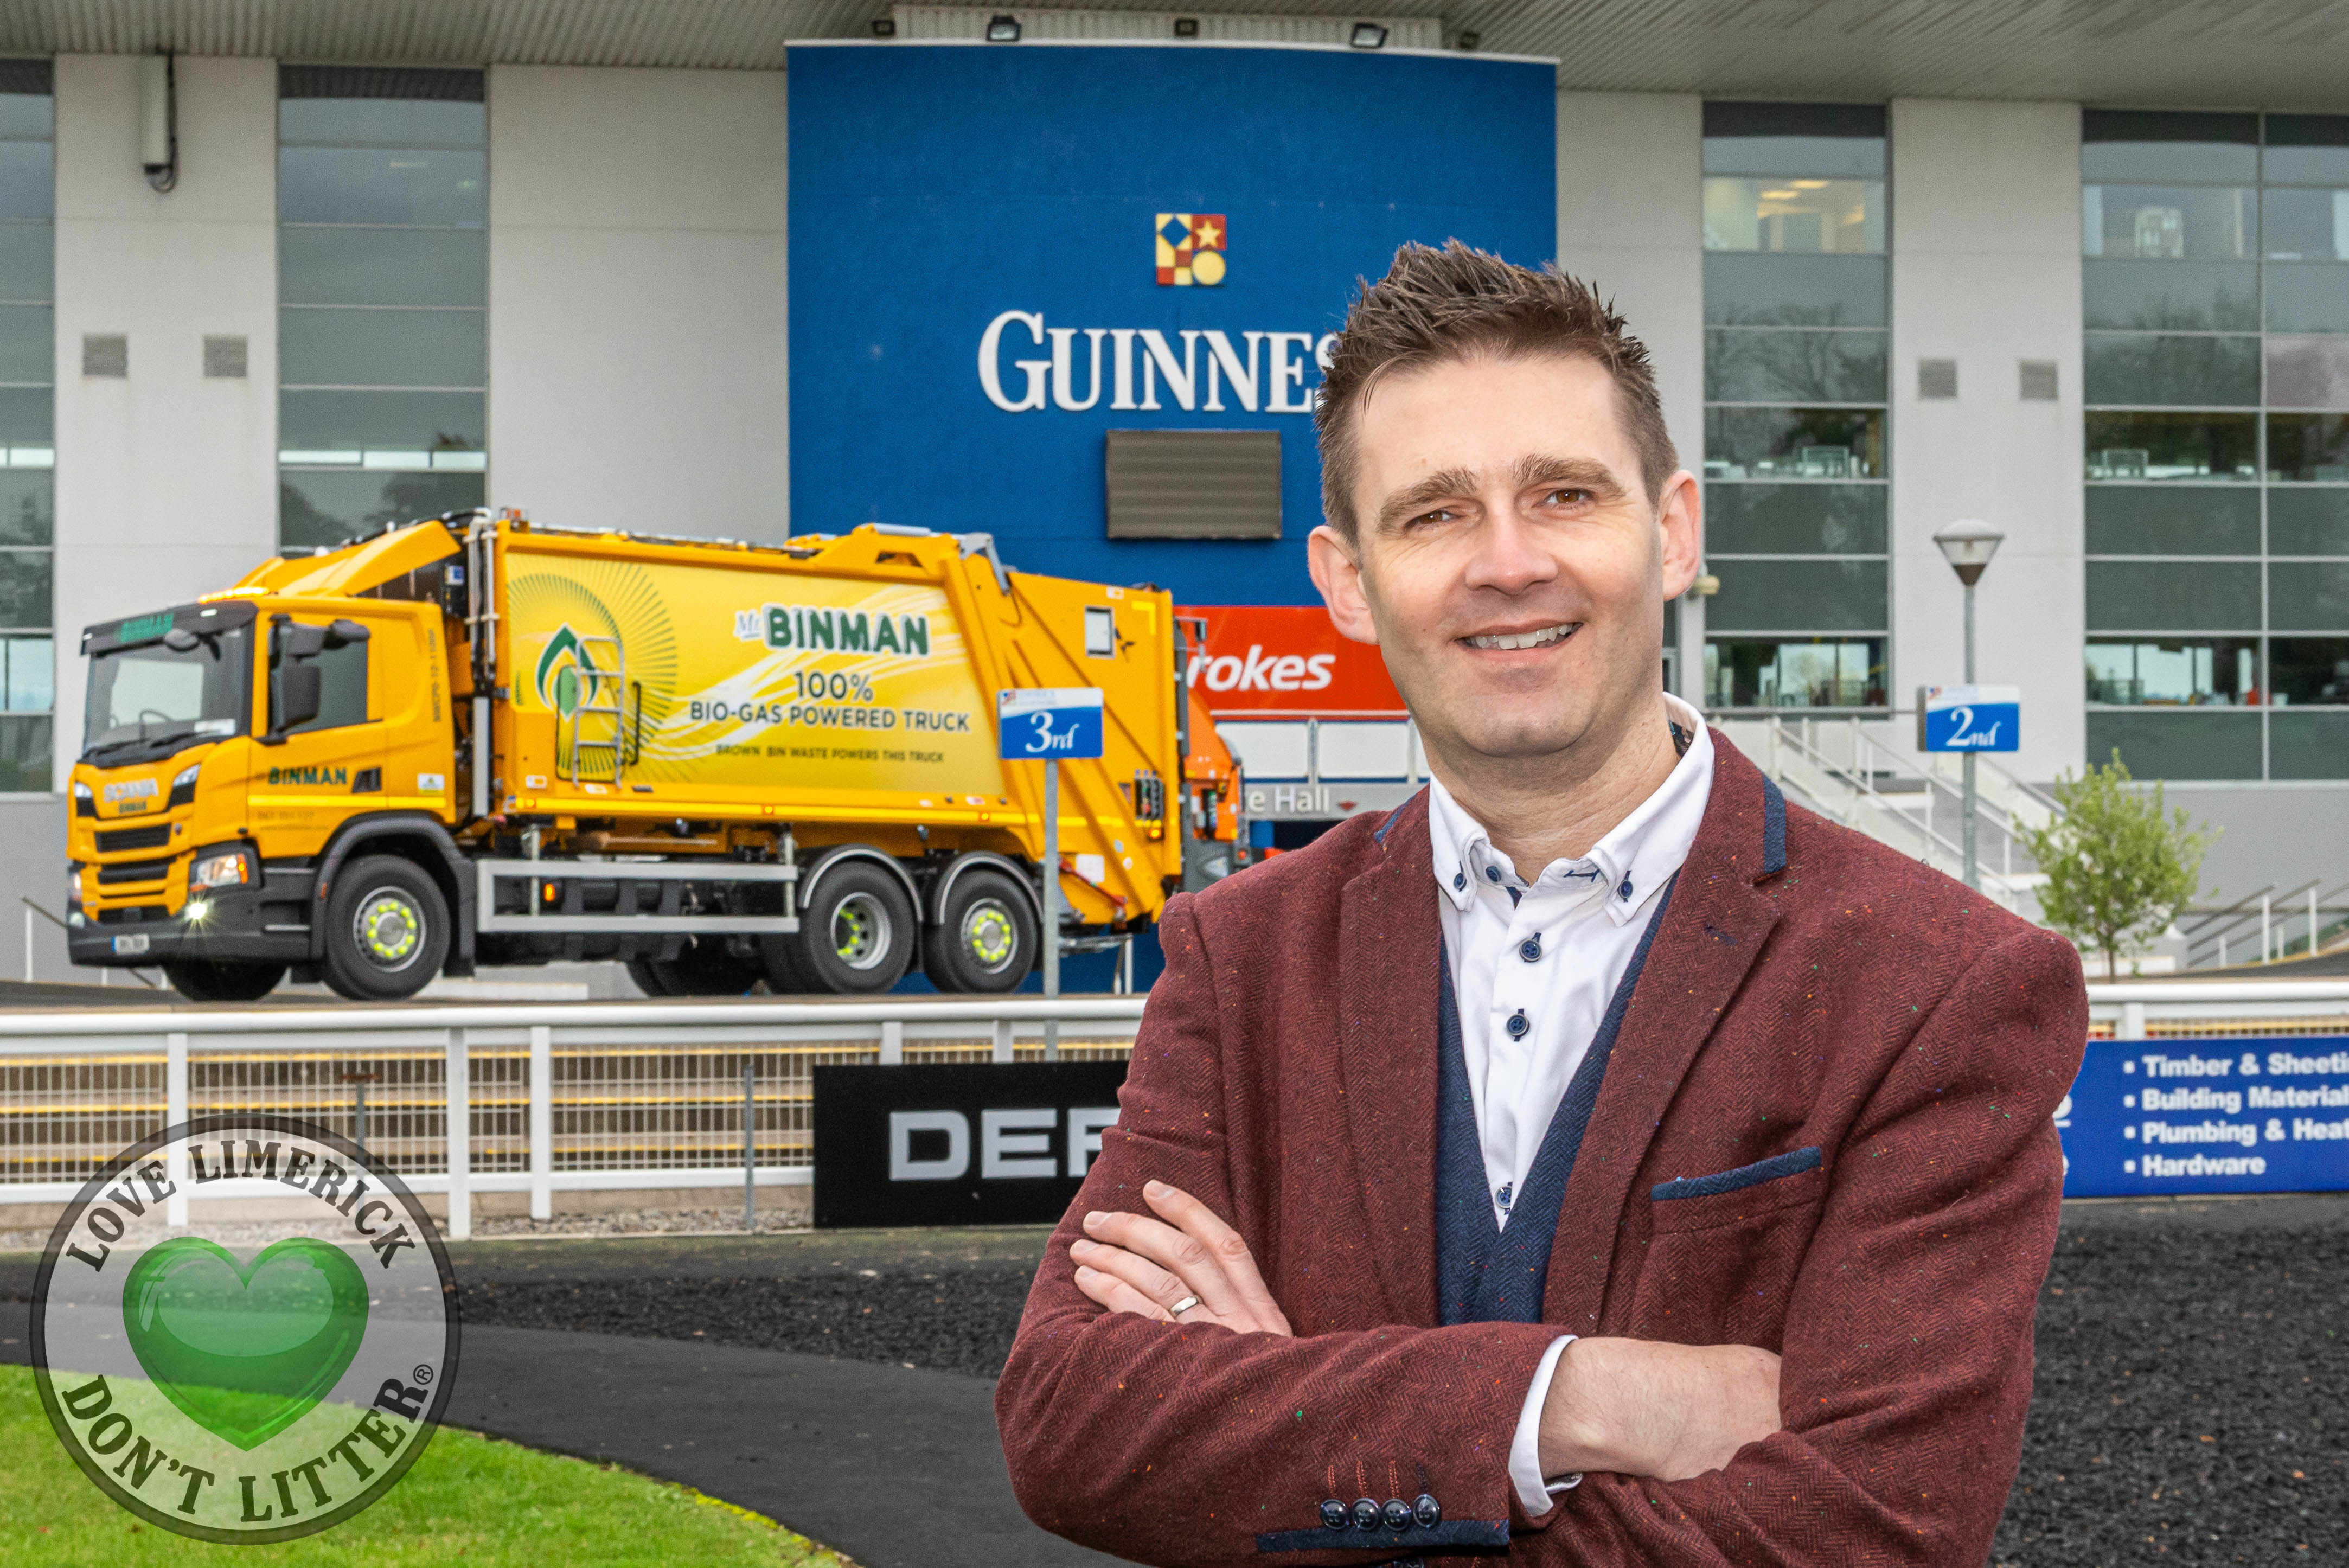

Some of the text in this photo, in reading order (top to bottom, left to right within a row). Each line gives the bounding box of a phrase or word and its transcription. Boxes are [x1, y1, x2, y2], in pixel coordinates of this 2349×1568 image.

[765, 606, 929, 656] BINMAN
[1186, 644, 1336, 692] rokes
[795, 671, 874, 701] 100%
[690, 701, 970, 731] BIO-GAS POWERED TRUCK
[1946, 706, 2001, 746] 2nd
[1025, 711, 1080, 753] 3rd
[716, 744, 944, 763] BROWN BIN WASTE POWERS THIS TRUCK
[268, 766, 347, 785] BINMAN
[1274, 786, 1330, 812] Hall
[2141, 1053, 2233, 1077] Timber
[2239, 1052, 2261, 1076] &
[2141, 1084, 2349, 1115] Building Material
[2141, 1120, 2257, 1147] Plumbing
[2264, 1118, 2287, 1141] &
[2141, 1154, 2267, 1177] Hardware
